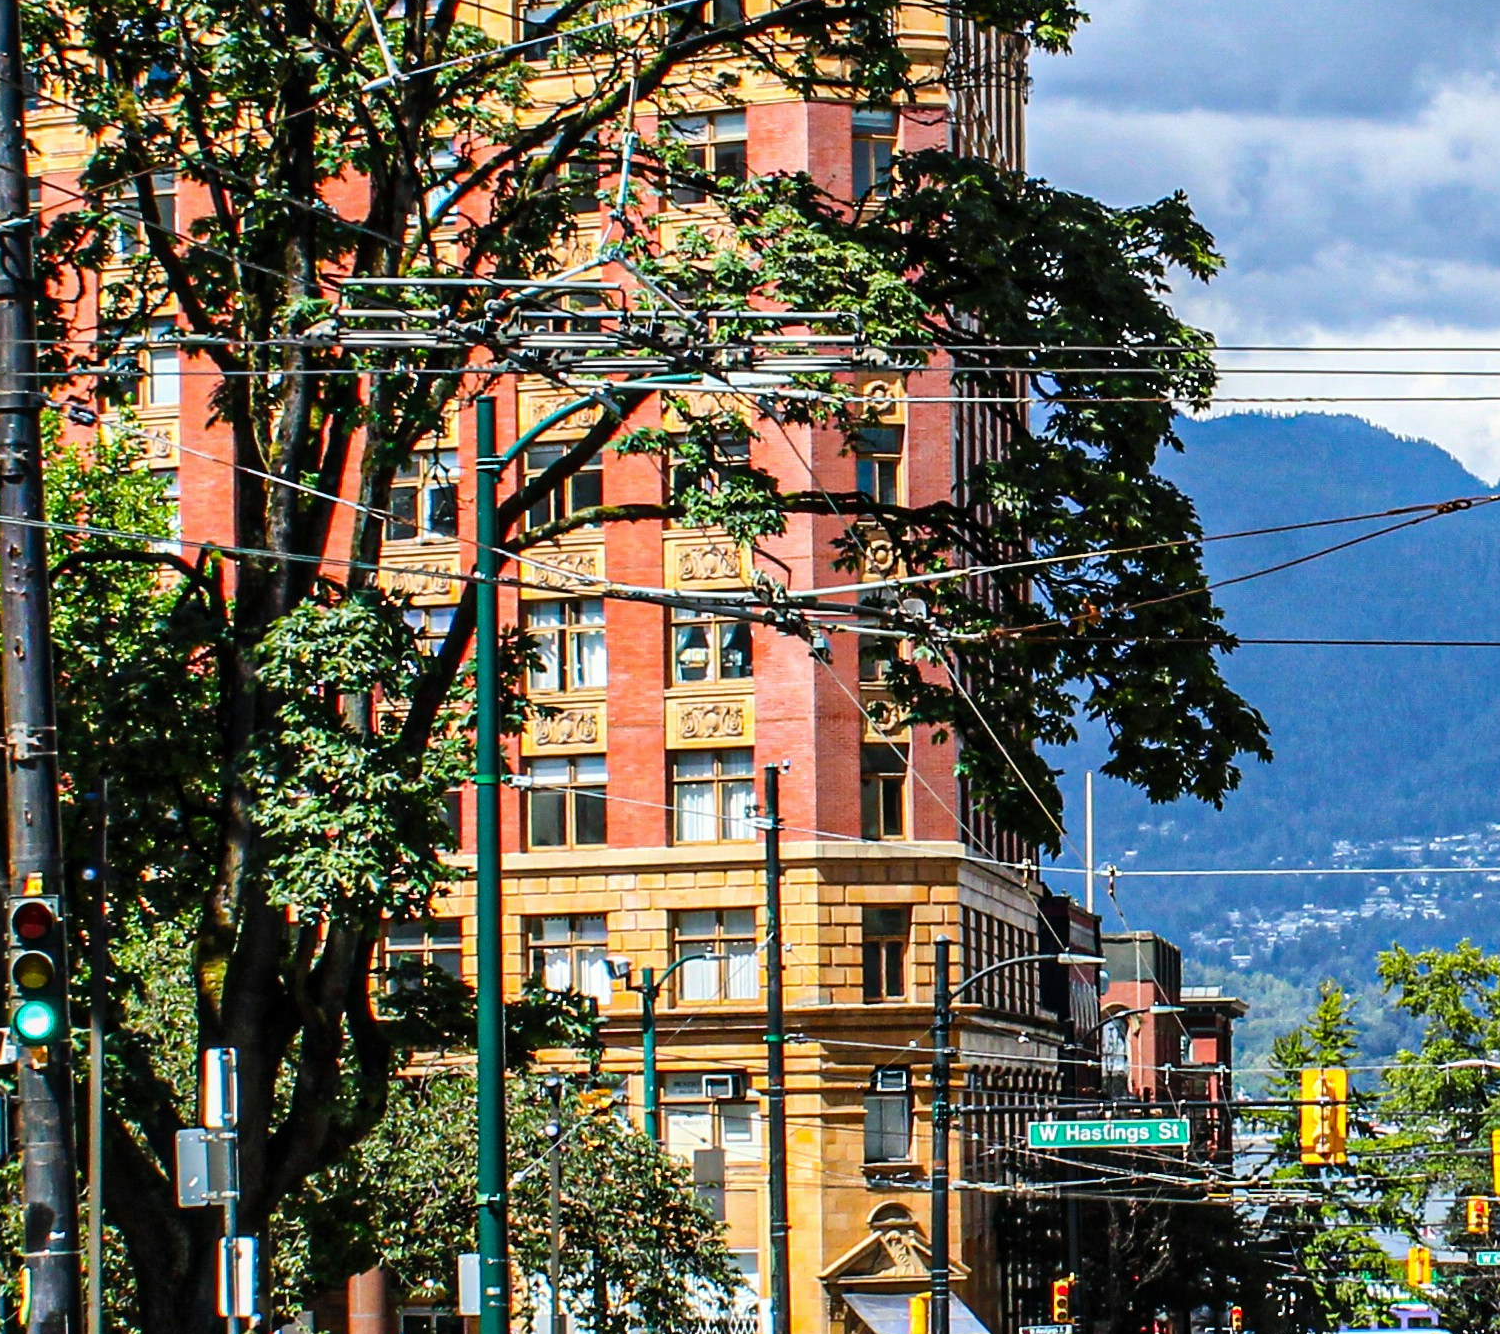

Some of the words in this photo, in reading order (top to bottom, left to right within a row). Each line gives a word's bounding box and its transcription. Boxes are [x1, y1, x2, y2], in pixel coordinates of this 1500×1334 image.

[1038, 1124, 1058, 1142] W
[1065, 1123, 1150, 1144] Hastings
[1158, 1122, 1180, 1140] St
